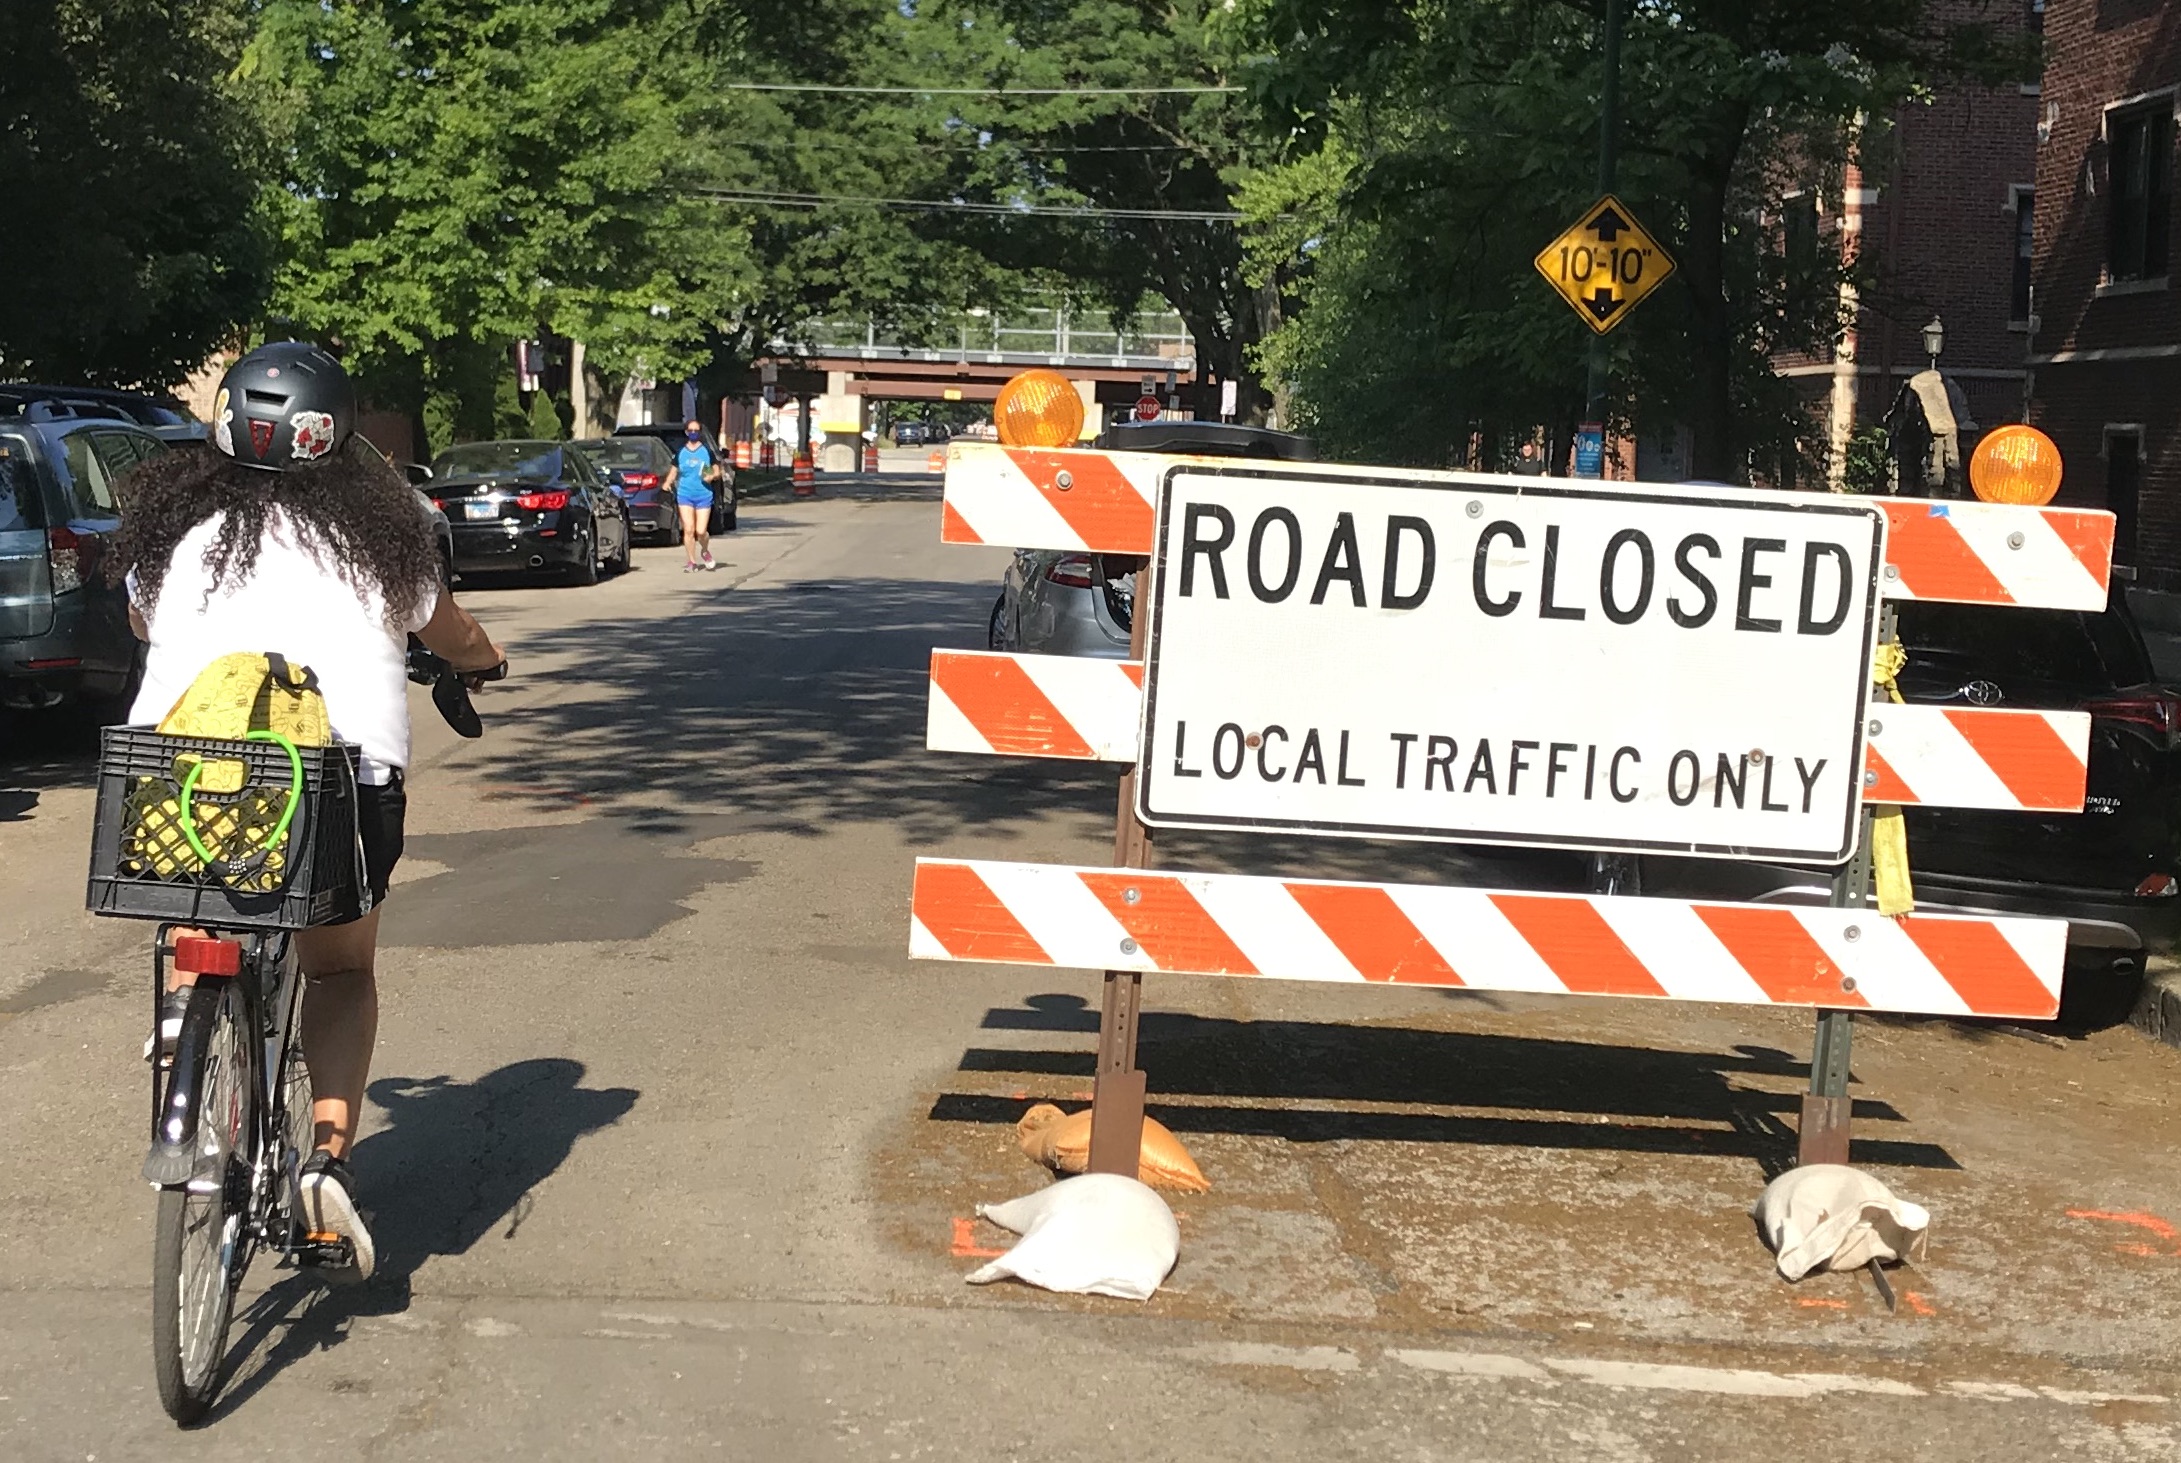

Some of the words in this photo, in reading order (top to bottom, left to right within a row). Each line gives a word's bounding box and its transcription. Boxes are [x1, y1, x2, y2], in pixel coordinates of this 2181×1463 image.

[1137, 403, 1159, 414] STOP
[1179, 502, 1436, 610] ROAD
[1472, 520, 1853, 636] CLOSED
[1174, 720, 1366, 787] LOCAL
[1390, 732, 1641, 803] TRAFFIC
[1668, 749, 1828, 813] ONLY
